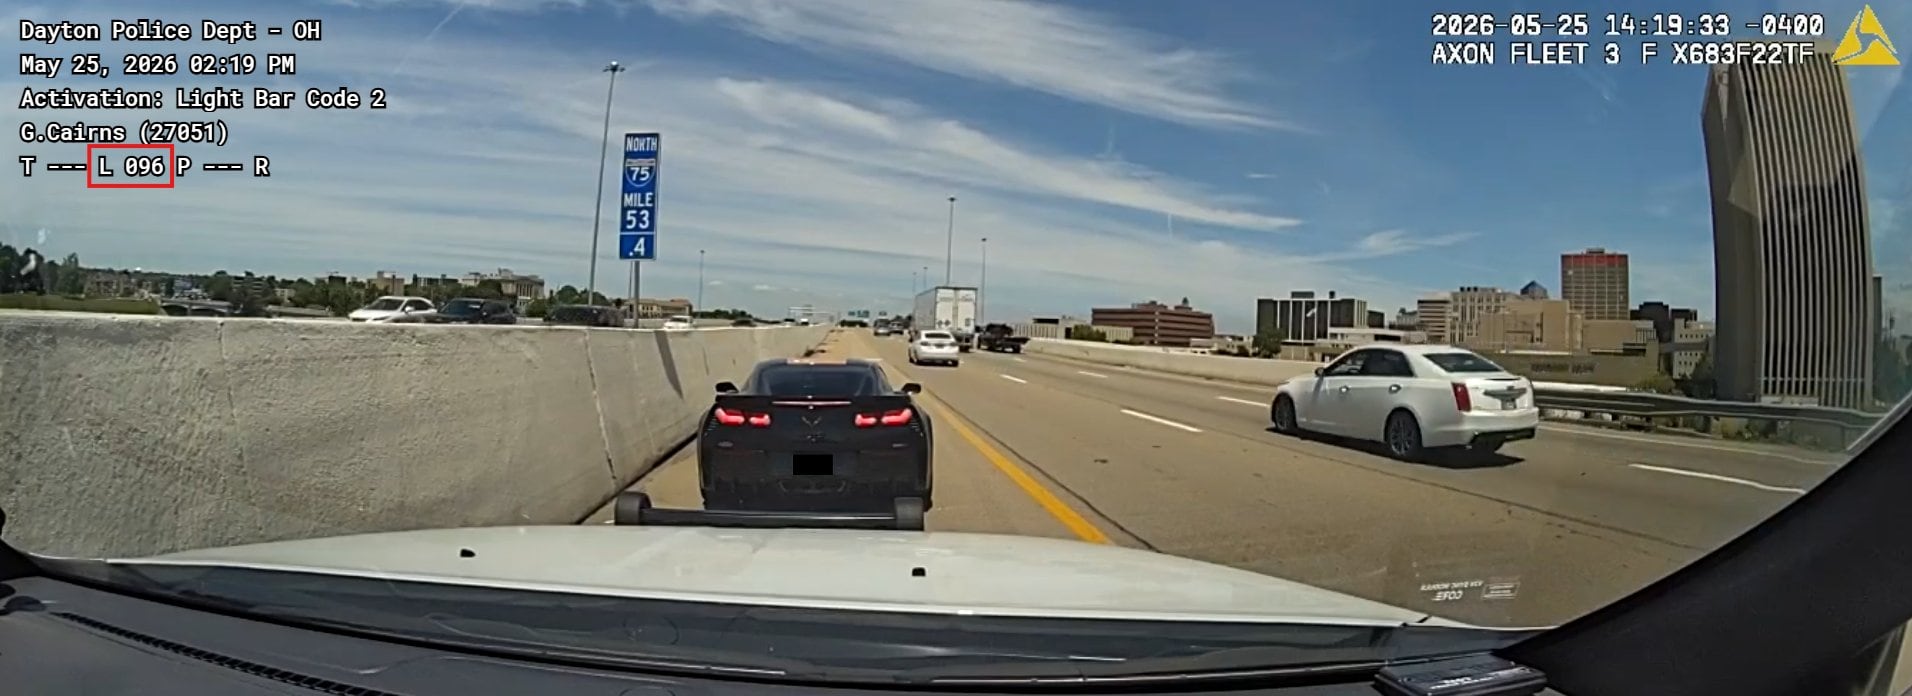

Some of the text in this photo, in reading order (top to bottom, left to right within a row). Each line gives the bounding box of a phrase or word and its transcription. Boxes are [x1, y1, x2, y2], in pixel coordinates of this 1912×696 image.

[626, 136, 658, 152] NORTH
[630, 167, 650, 181] 75
[623, 192, 654, 207] MILE
[626, 209, 650, 229] 53
[629, 237, 646, 257] .4
